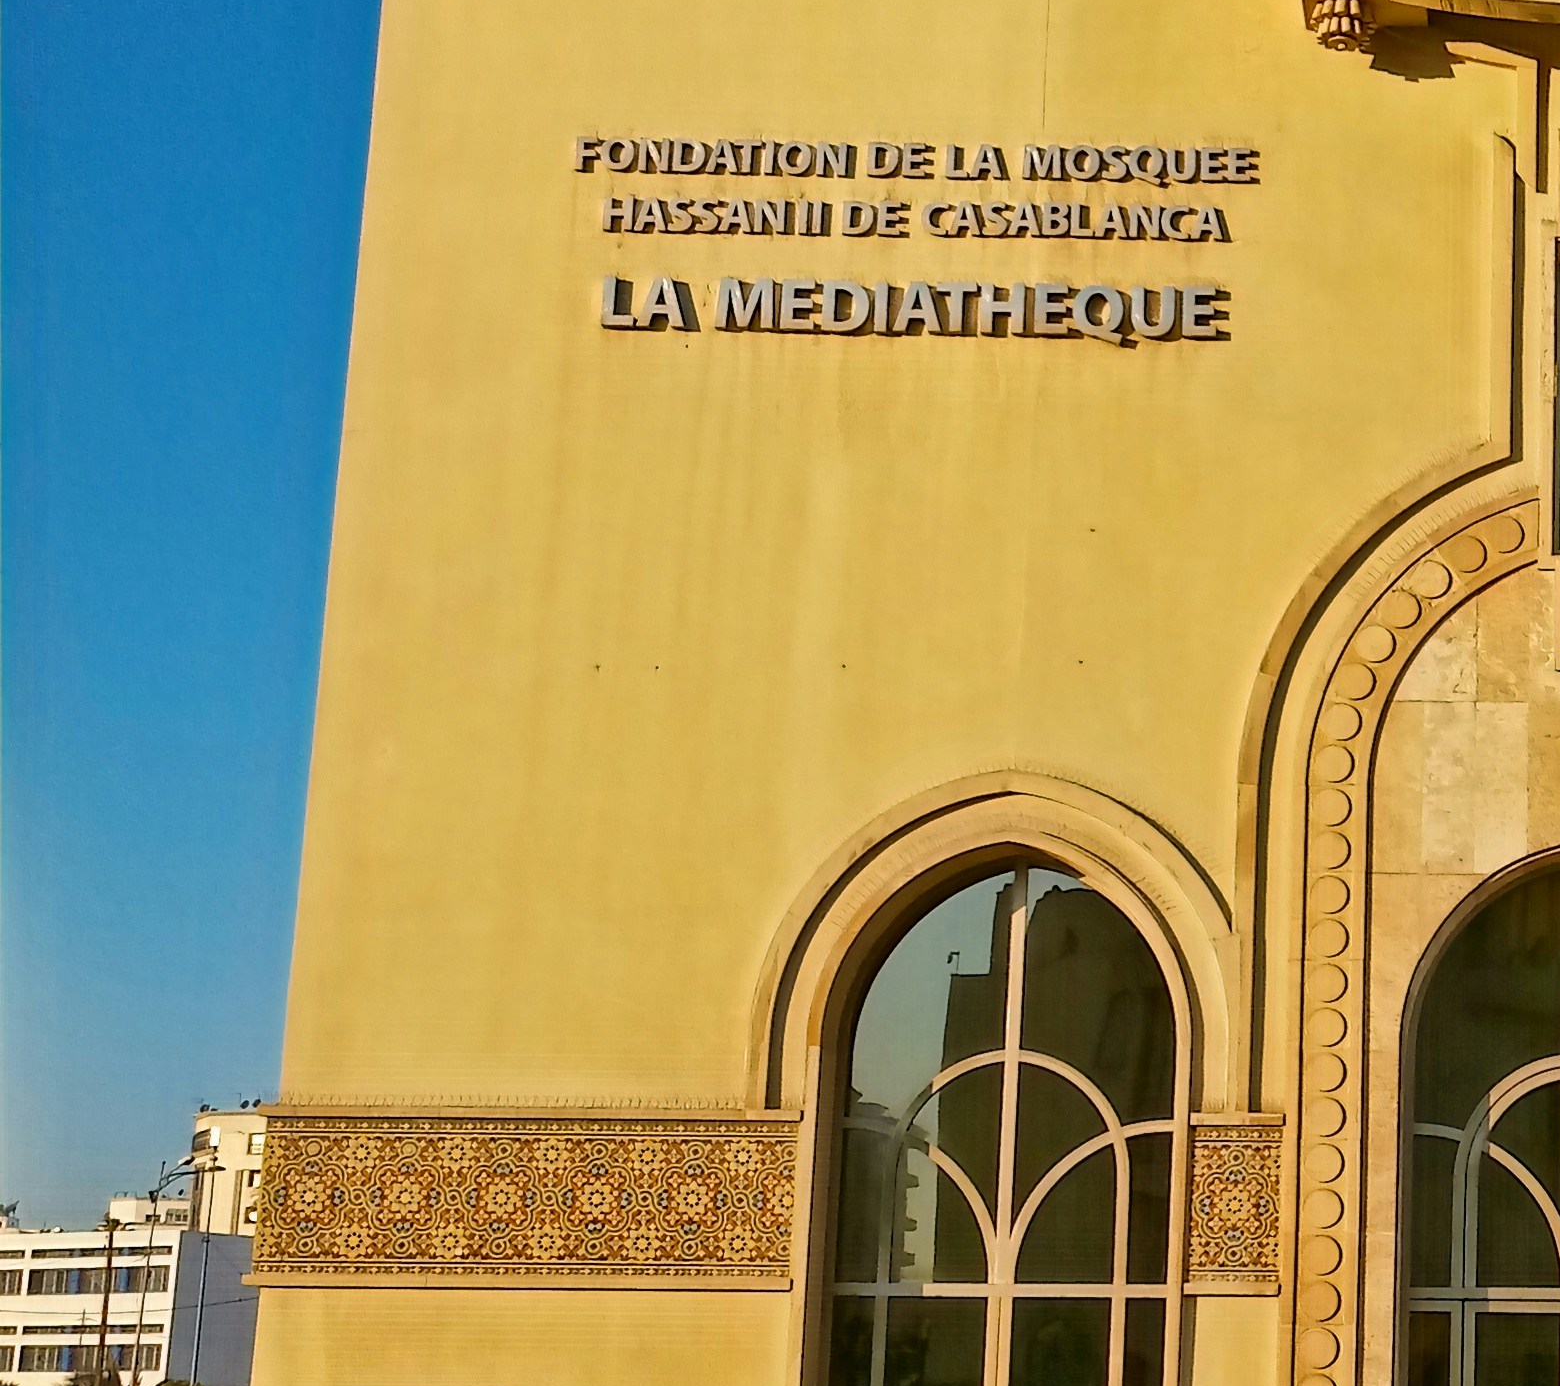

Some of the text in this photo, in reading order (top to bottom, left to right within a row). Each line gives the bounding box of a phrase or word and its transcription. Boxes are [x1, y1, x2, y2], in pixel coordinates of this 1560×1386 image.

[574, 134, 1260, 186] FONDATION DE LA MOSQUEE
[841, 200, 911, 238] DE
[921, 201, 1233, 242] CASABLANCA
[601, 275, 1231, 350] LA MEDIATHEQUE
